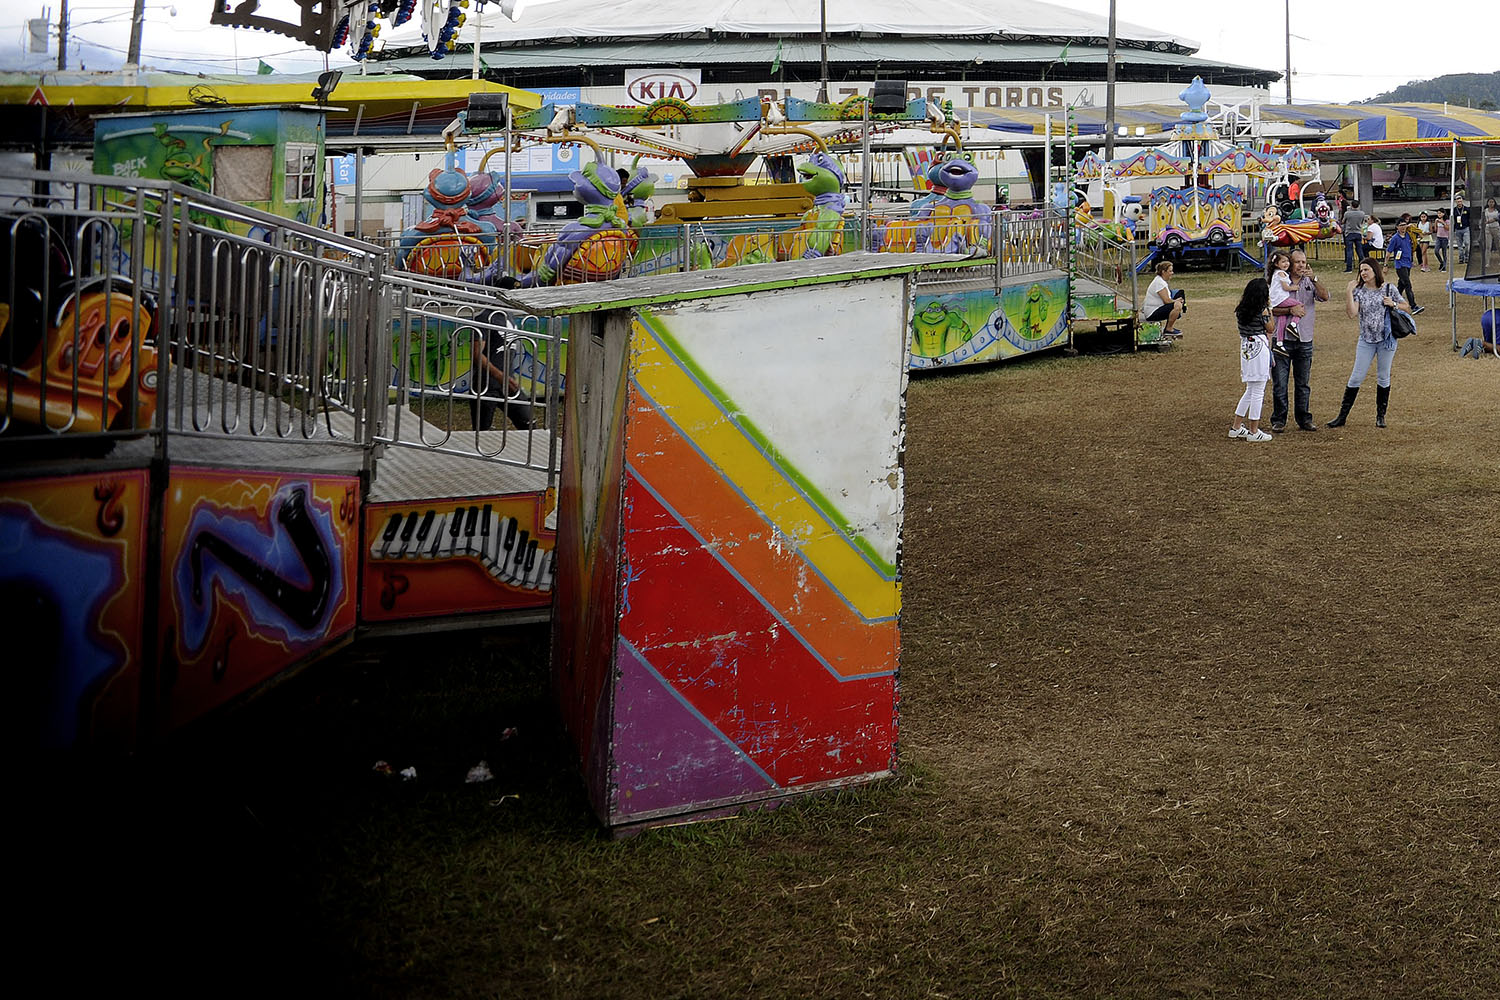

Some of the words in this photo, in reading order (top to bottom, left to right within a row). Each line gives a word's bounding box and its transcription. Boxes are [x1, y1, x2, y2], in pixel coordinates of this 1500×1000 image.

[640, 81, 684, 99] KIA
[962, 86, 1063, 107] TOROS
[112, 156, 148, 177] BACK
